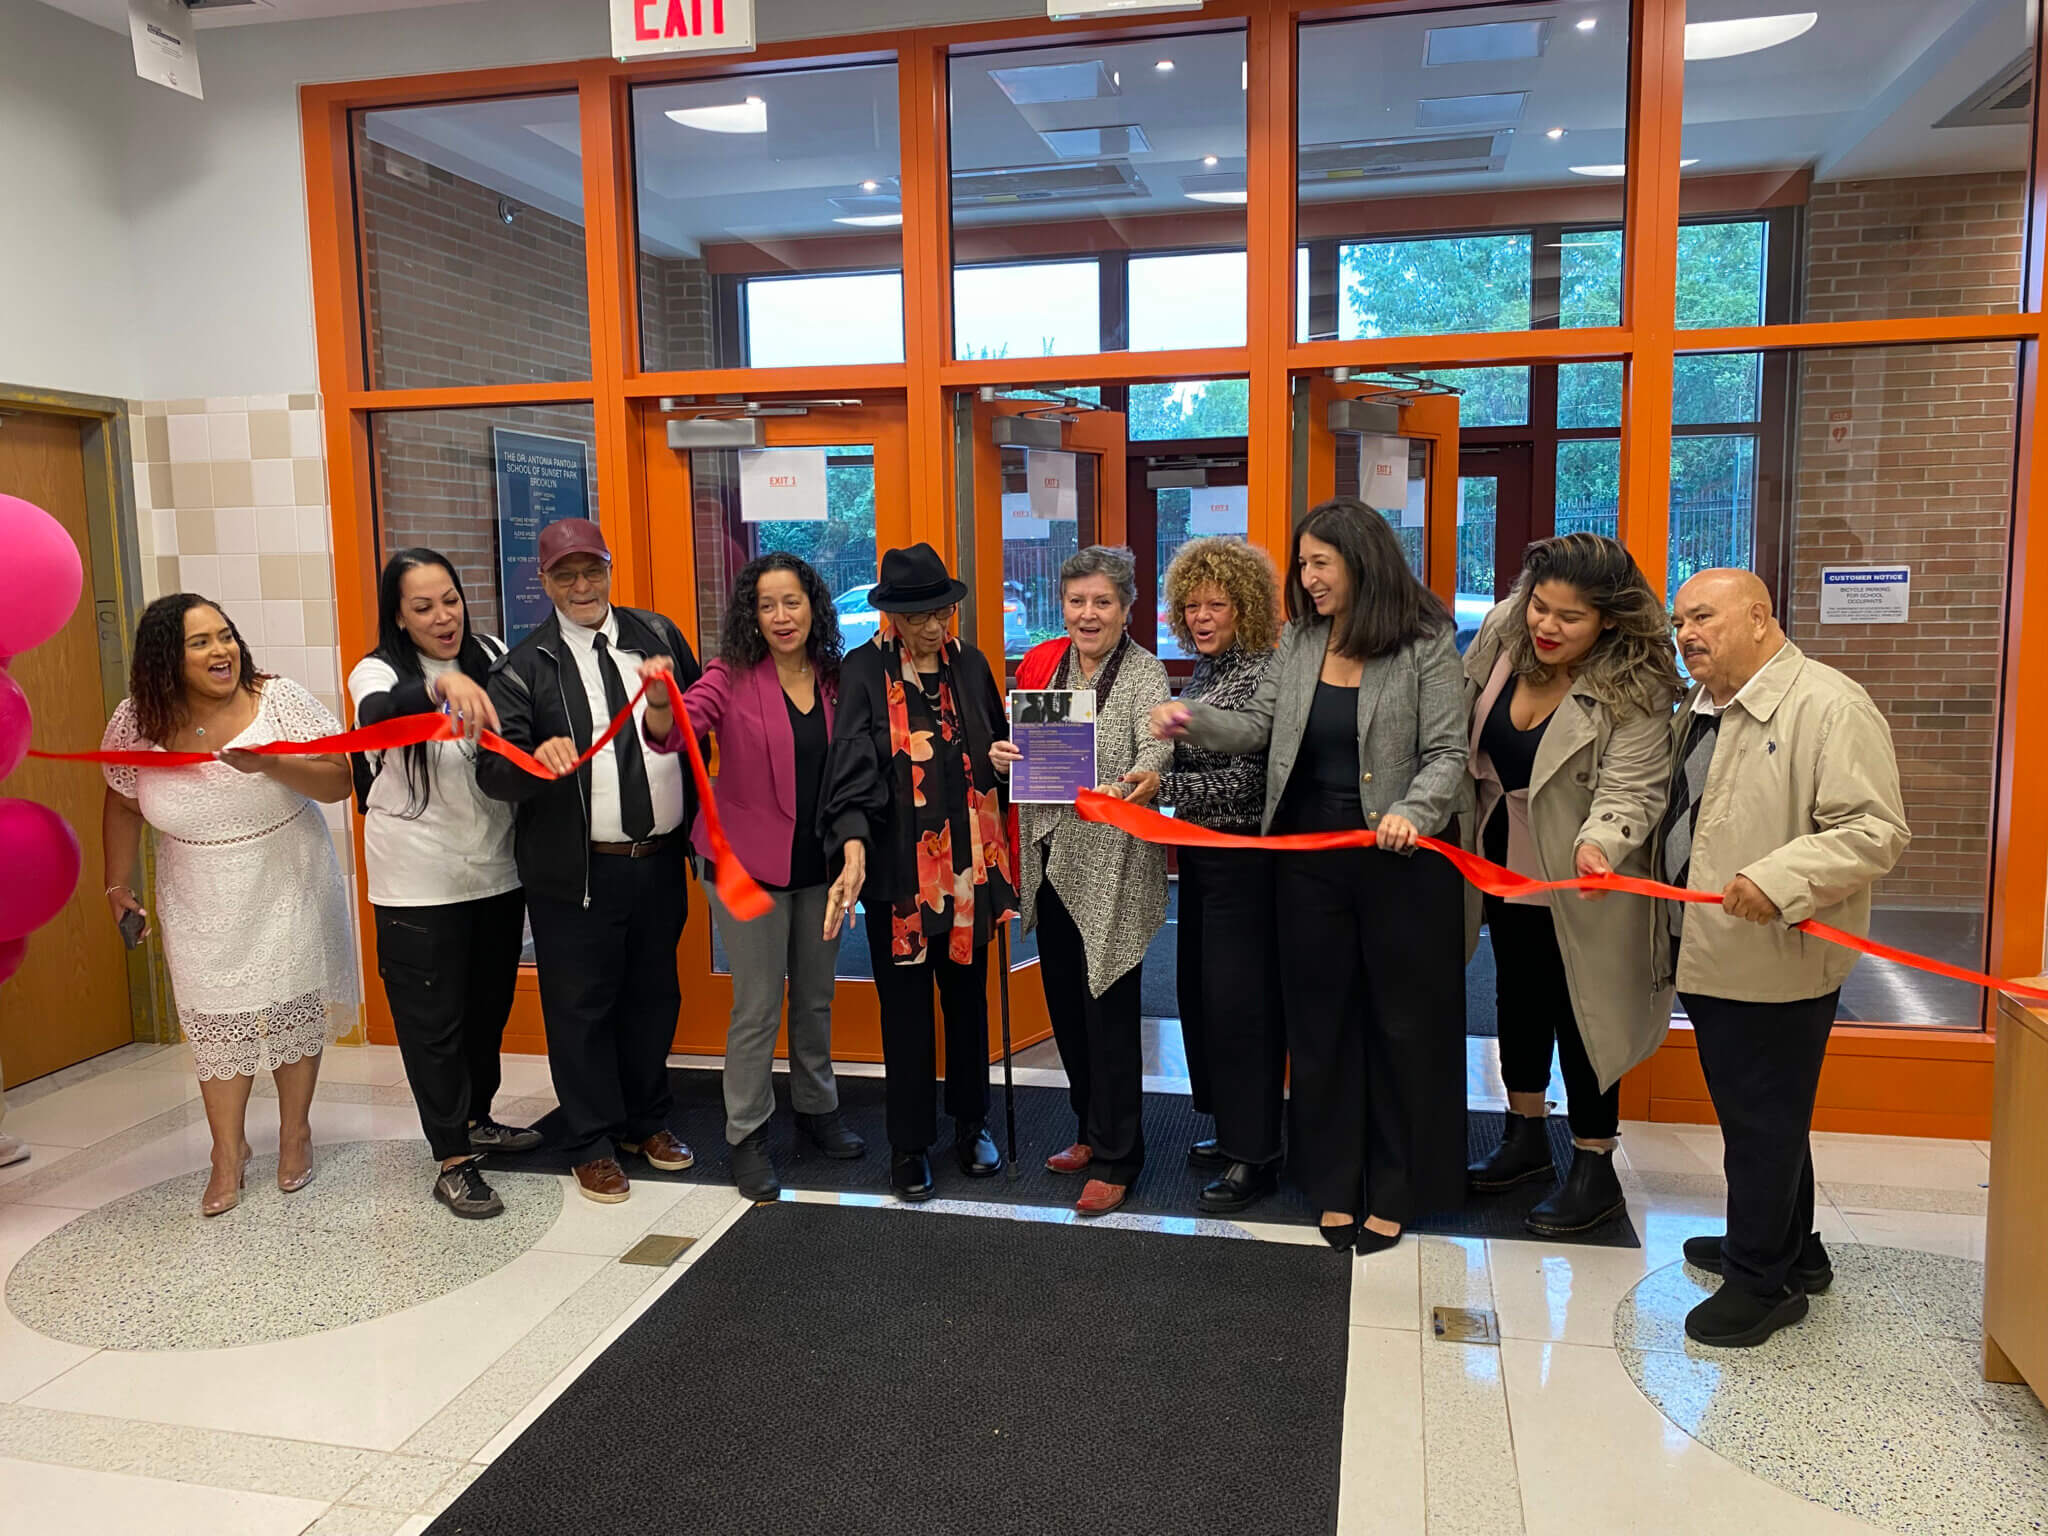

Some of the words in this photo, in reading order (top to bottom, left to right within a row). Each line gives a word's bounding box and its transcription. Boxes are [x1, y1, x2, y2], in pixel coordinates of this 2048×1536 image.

[504, 451, 516, 462] THE
[528, 455, 553, 466] ANTONIA
[553, 458, 577, 468] PANTOJA
[506, 463, 531, 475] SCHOOL
[532, 466, 540, 476] OF
[541, 467, 562, 478] SUNSET
[563, 470, 577, 480] PARK
[1376, 464, 1388, 473] EXIT
[530, 477, 557, 488] BROOKLYN
[769, 476, 789, 486] EXIT
